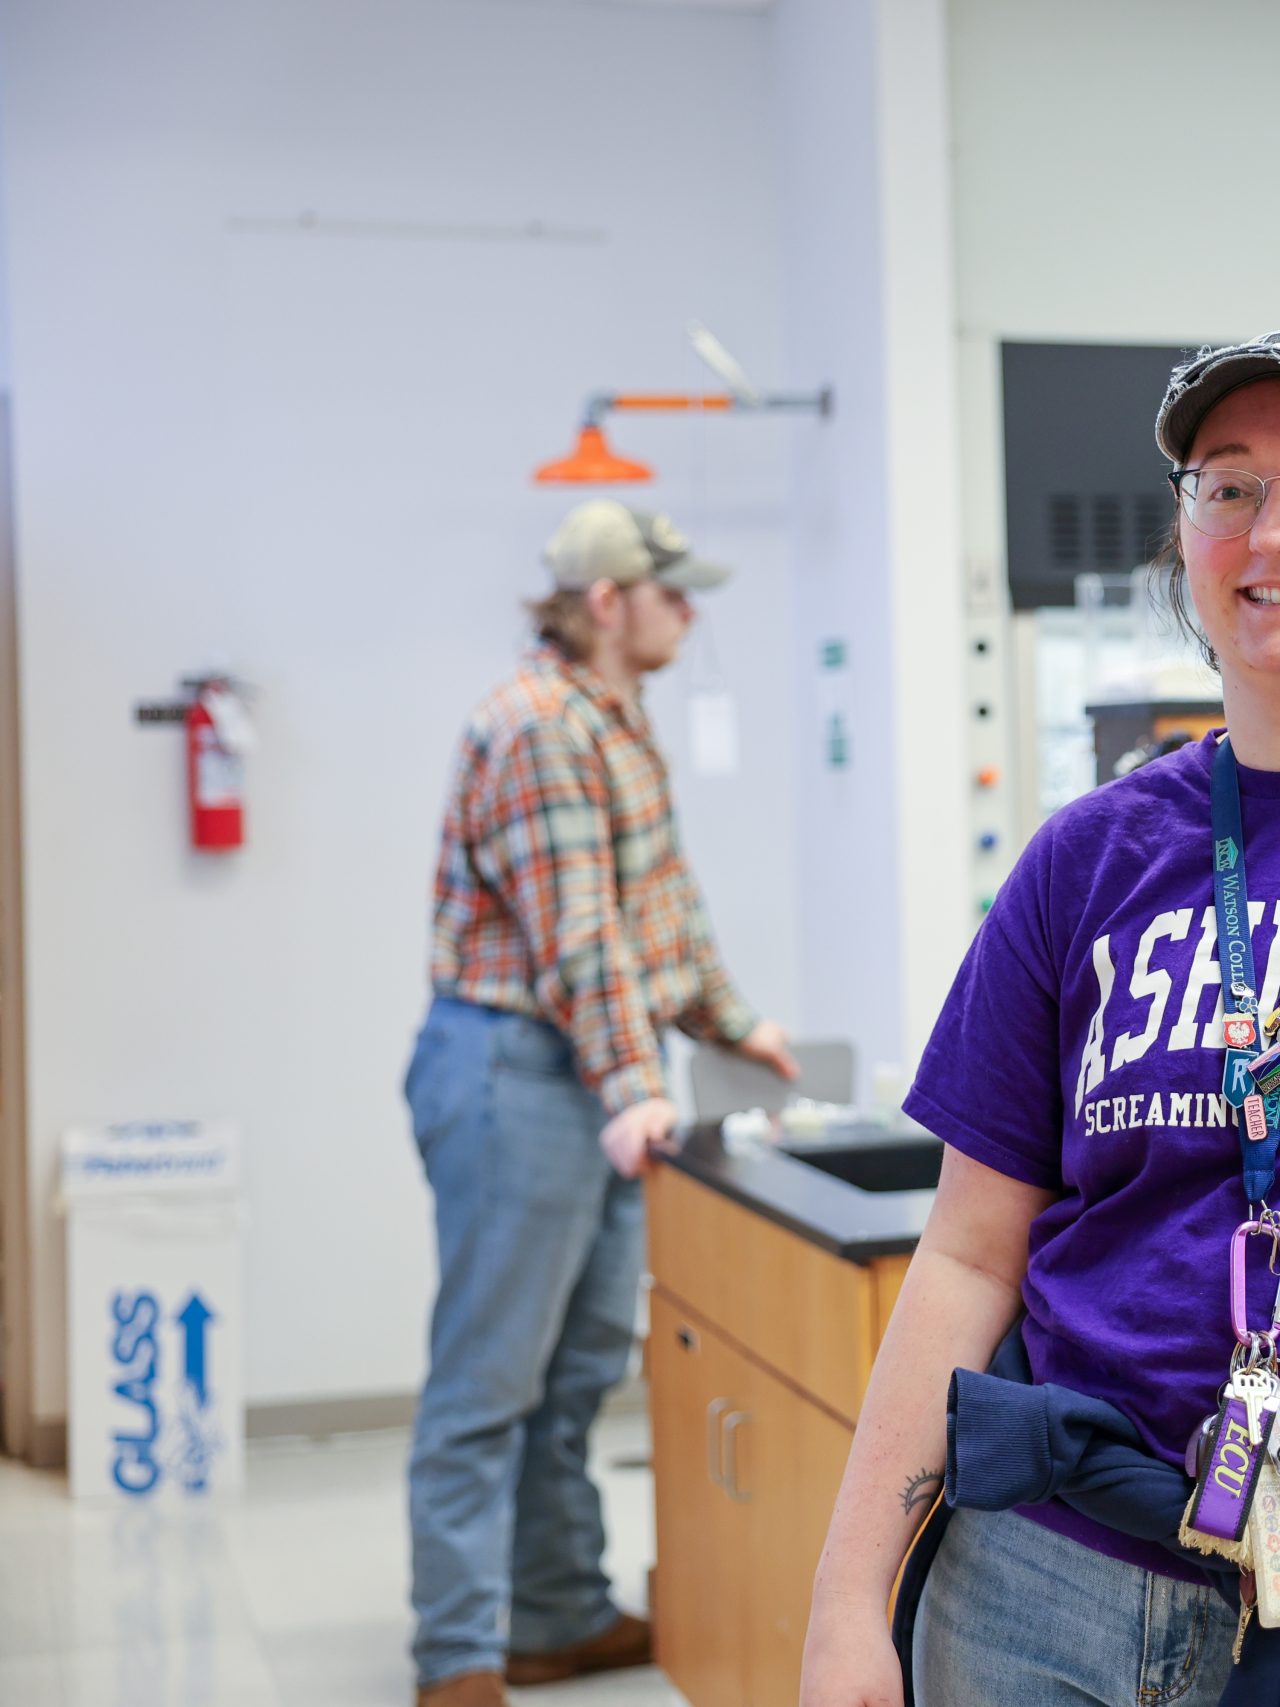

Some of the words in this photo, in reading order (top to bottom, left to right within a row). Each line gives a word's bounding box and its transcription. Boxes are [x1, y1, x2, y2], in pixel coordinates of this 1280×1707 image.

[1222, 872, 1240, 937] WATSON
[1247, 1097, 1265, 1139] TEACHER
[112, 1291, 160, 1495] GLASS
[1213, 1417, 1254, 1499] ECU
